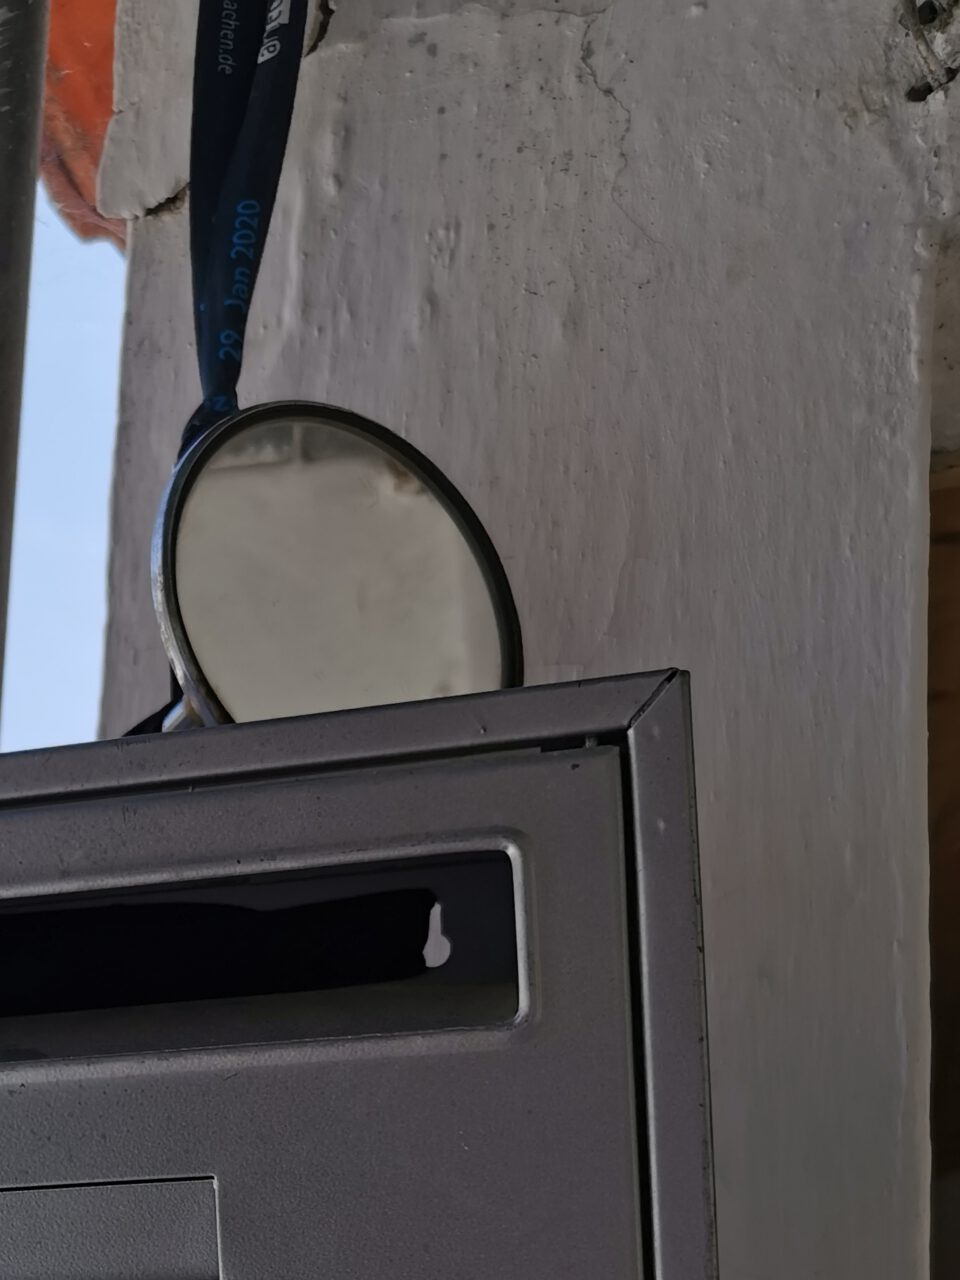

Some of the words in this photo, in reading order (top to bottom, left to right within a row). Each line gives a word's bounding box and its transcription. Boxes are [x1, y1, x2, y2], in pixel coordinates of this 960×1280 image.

[230, 200, 261, 260] 2020
[224, 267, 251, 313] Jan
[218, 328, 242, 362] 29
